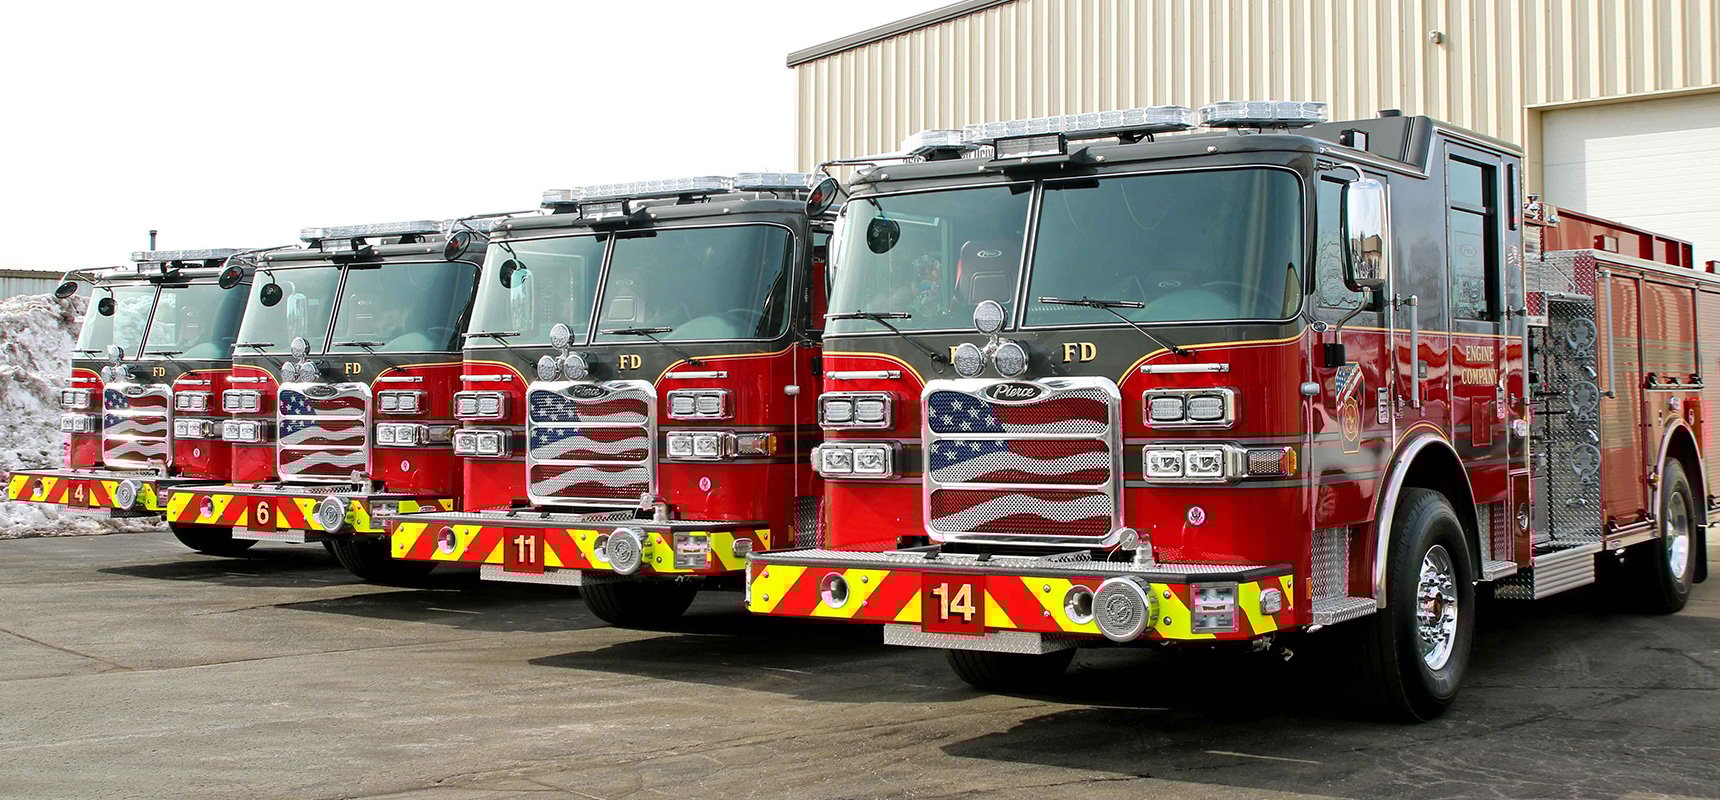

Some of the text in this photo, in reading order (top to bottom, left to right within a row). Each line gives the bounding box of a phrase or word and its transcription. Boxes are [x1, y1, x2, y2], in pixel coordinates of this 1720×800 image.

[1062, 342, 1097, 363] FD
[1465, 345, 1494, 362] ENGINE
[344, 362, 362, 376] FD
[619, 354, 642, 370] FD
[152, 366, 166, 377] FD
[1461, 368, 1499, 385] COMPANY
[993, 384, 1036, 402] Pierce
[74, 483, 84, 502] 4
[256, 501, 270, 525] 6
[514, 534, 536, 563] 11
[932, 582, 976, 621] 14
